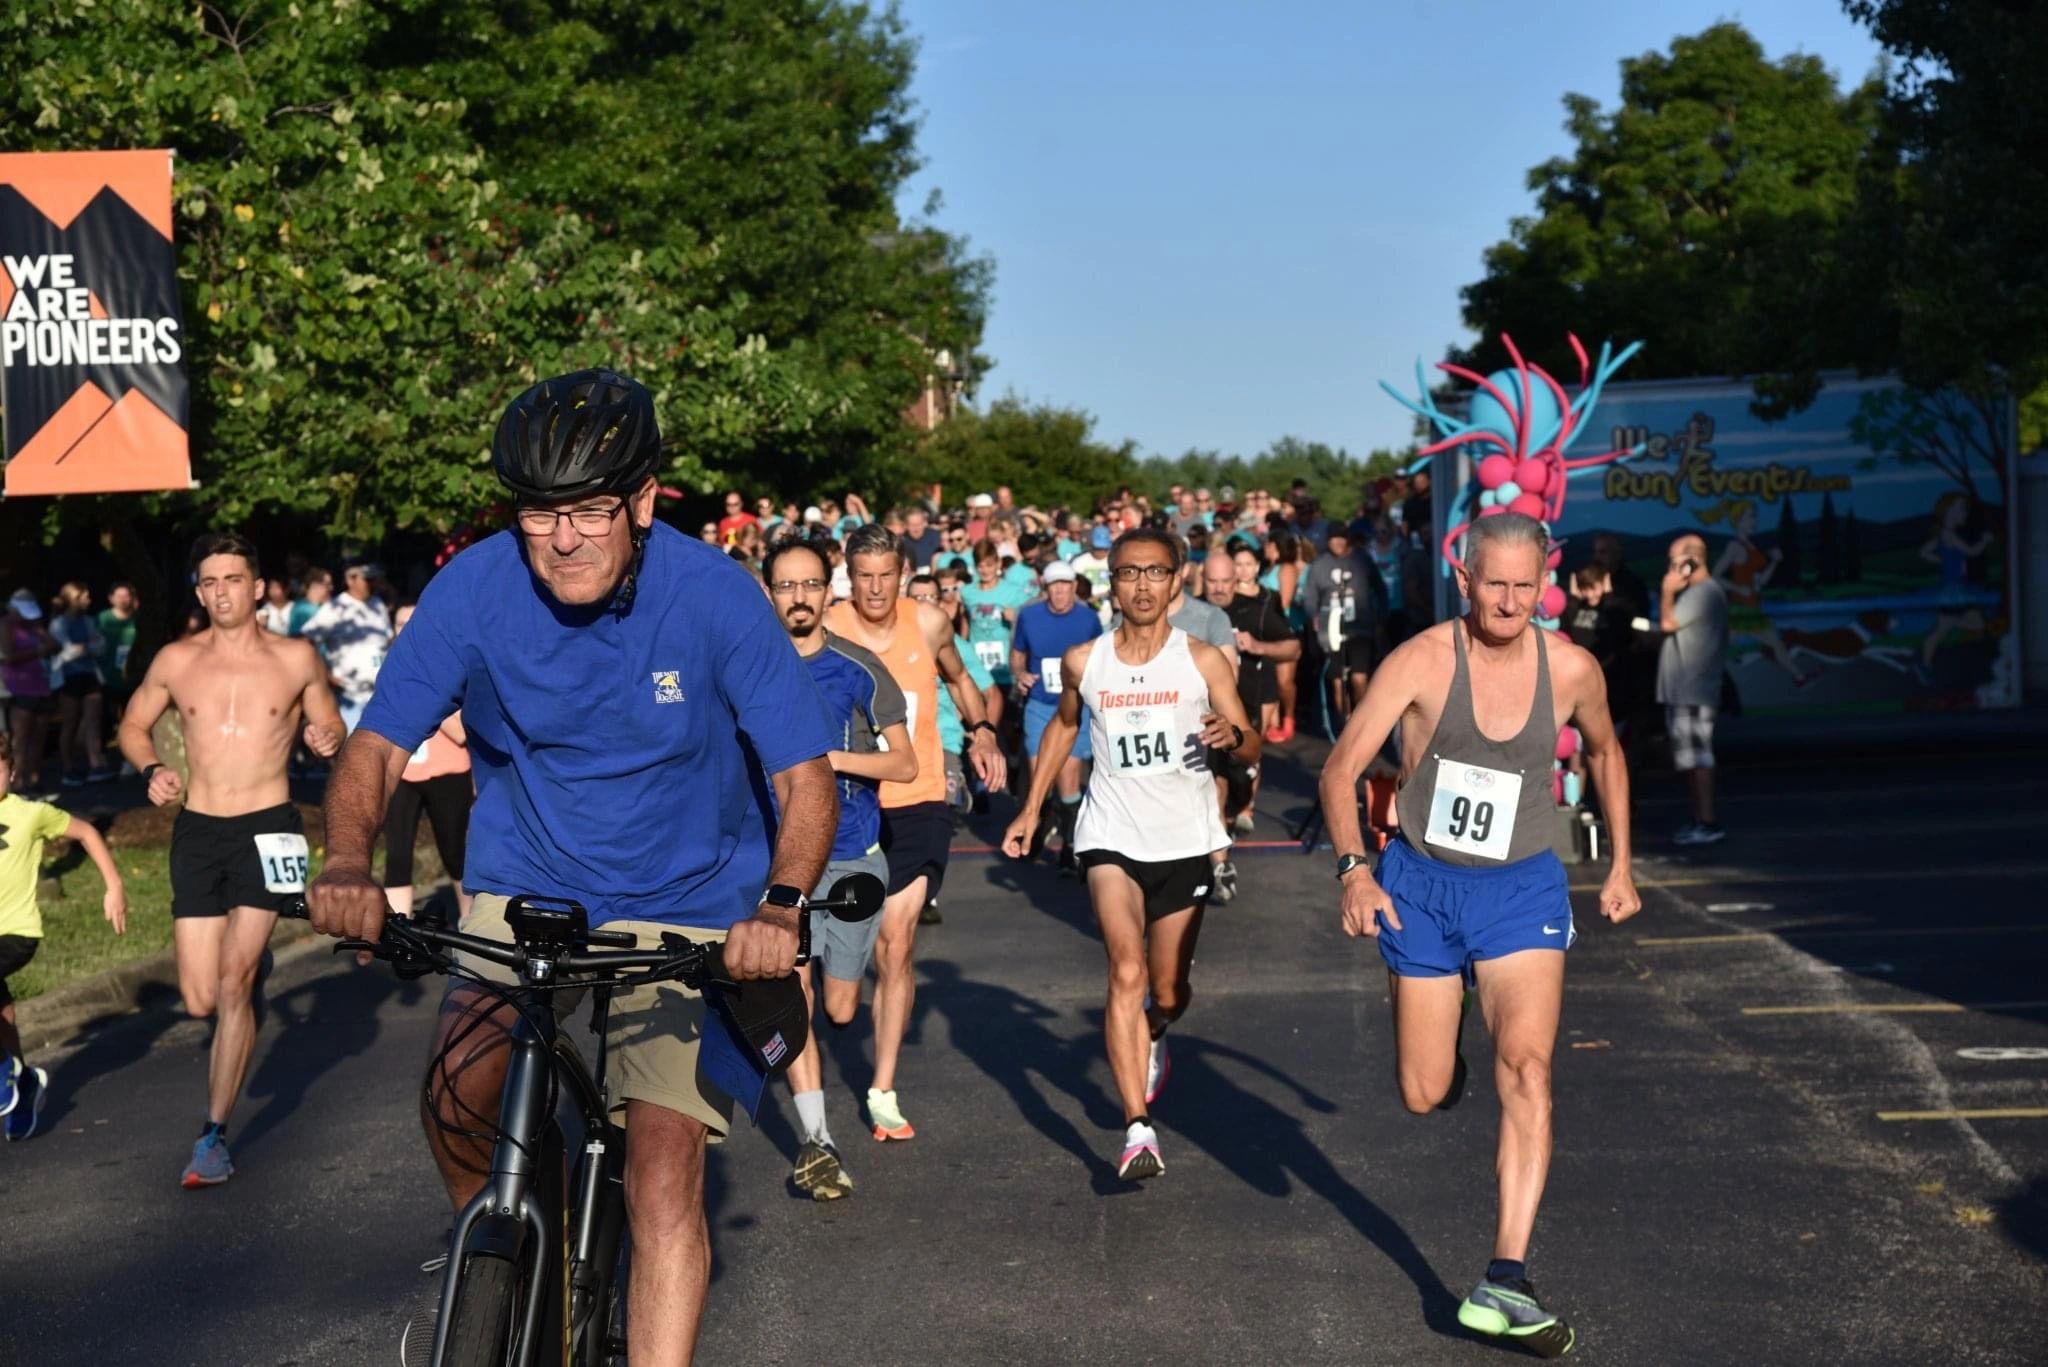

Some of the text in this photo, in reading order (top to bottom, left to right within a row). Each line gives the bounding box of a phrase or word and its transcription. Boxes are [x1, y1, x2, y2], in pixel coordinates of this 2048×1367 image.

[3, 254, 76, 289] WE
[6, 288, 91, 321] ARE
[1, 317, 182, 367] PIONEERS
[1606, 466, 1680, 507] Run
[1117, 731, 1170, 768] 154
[1449, 796, 1495, 842] 99
[269, 856, 308, 884] 155
